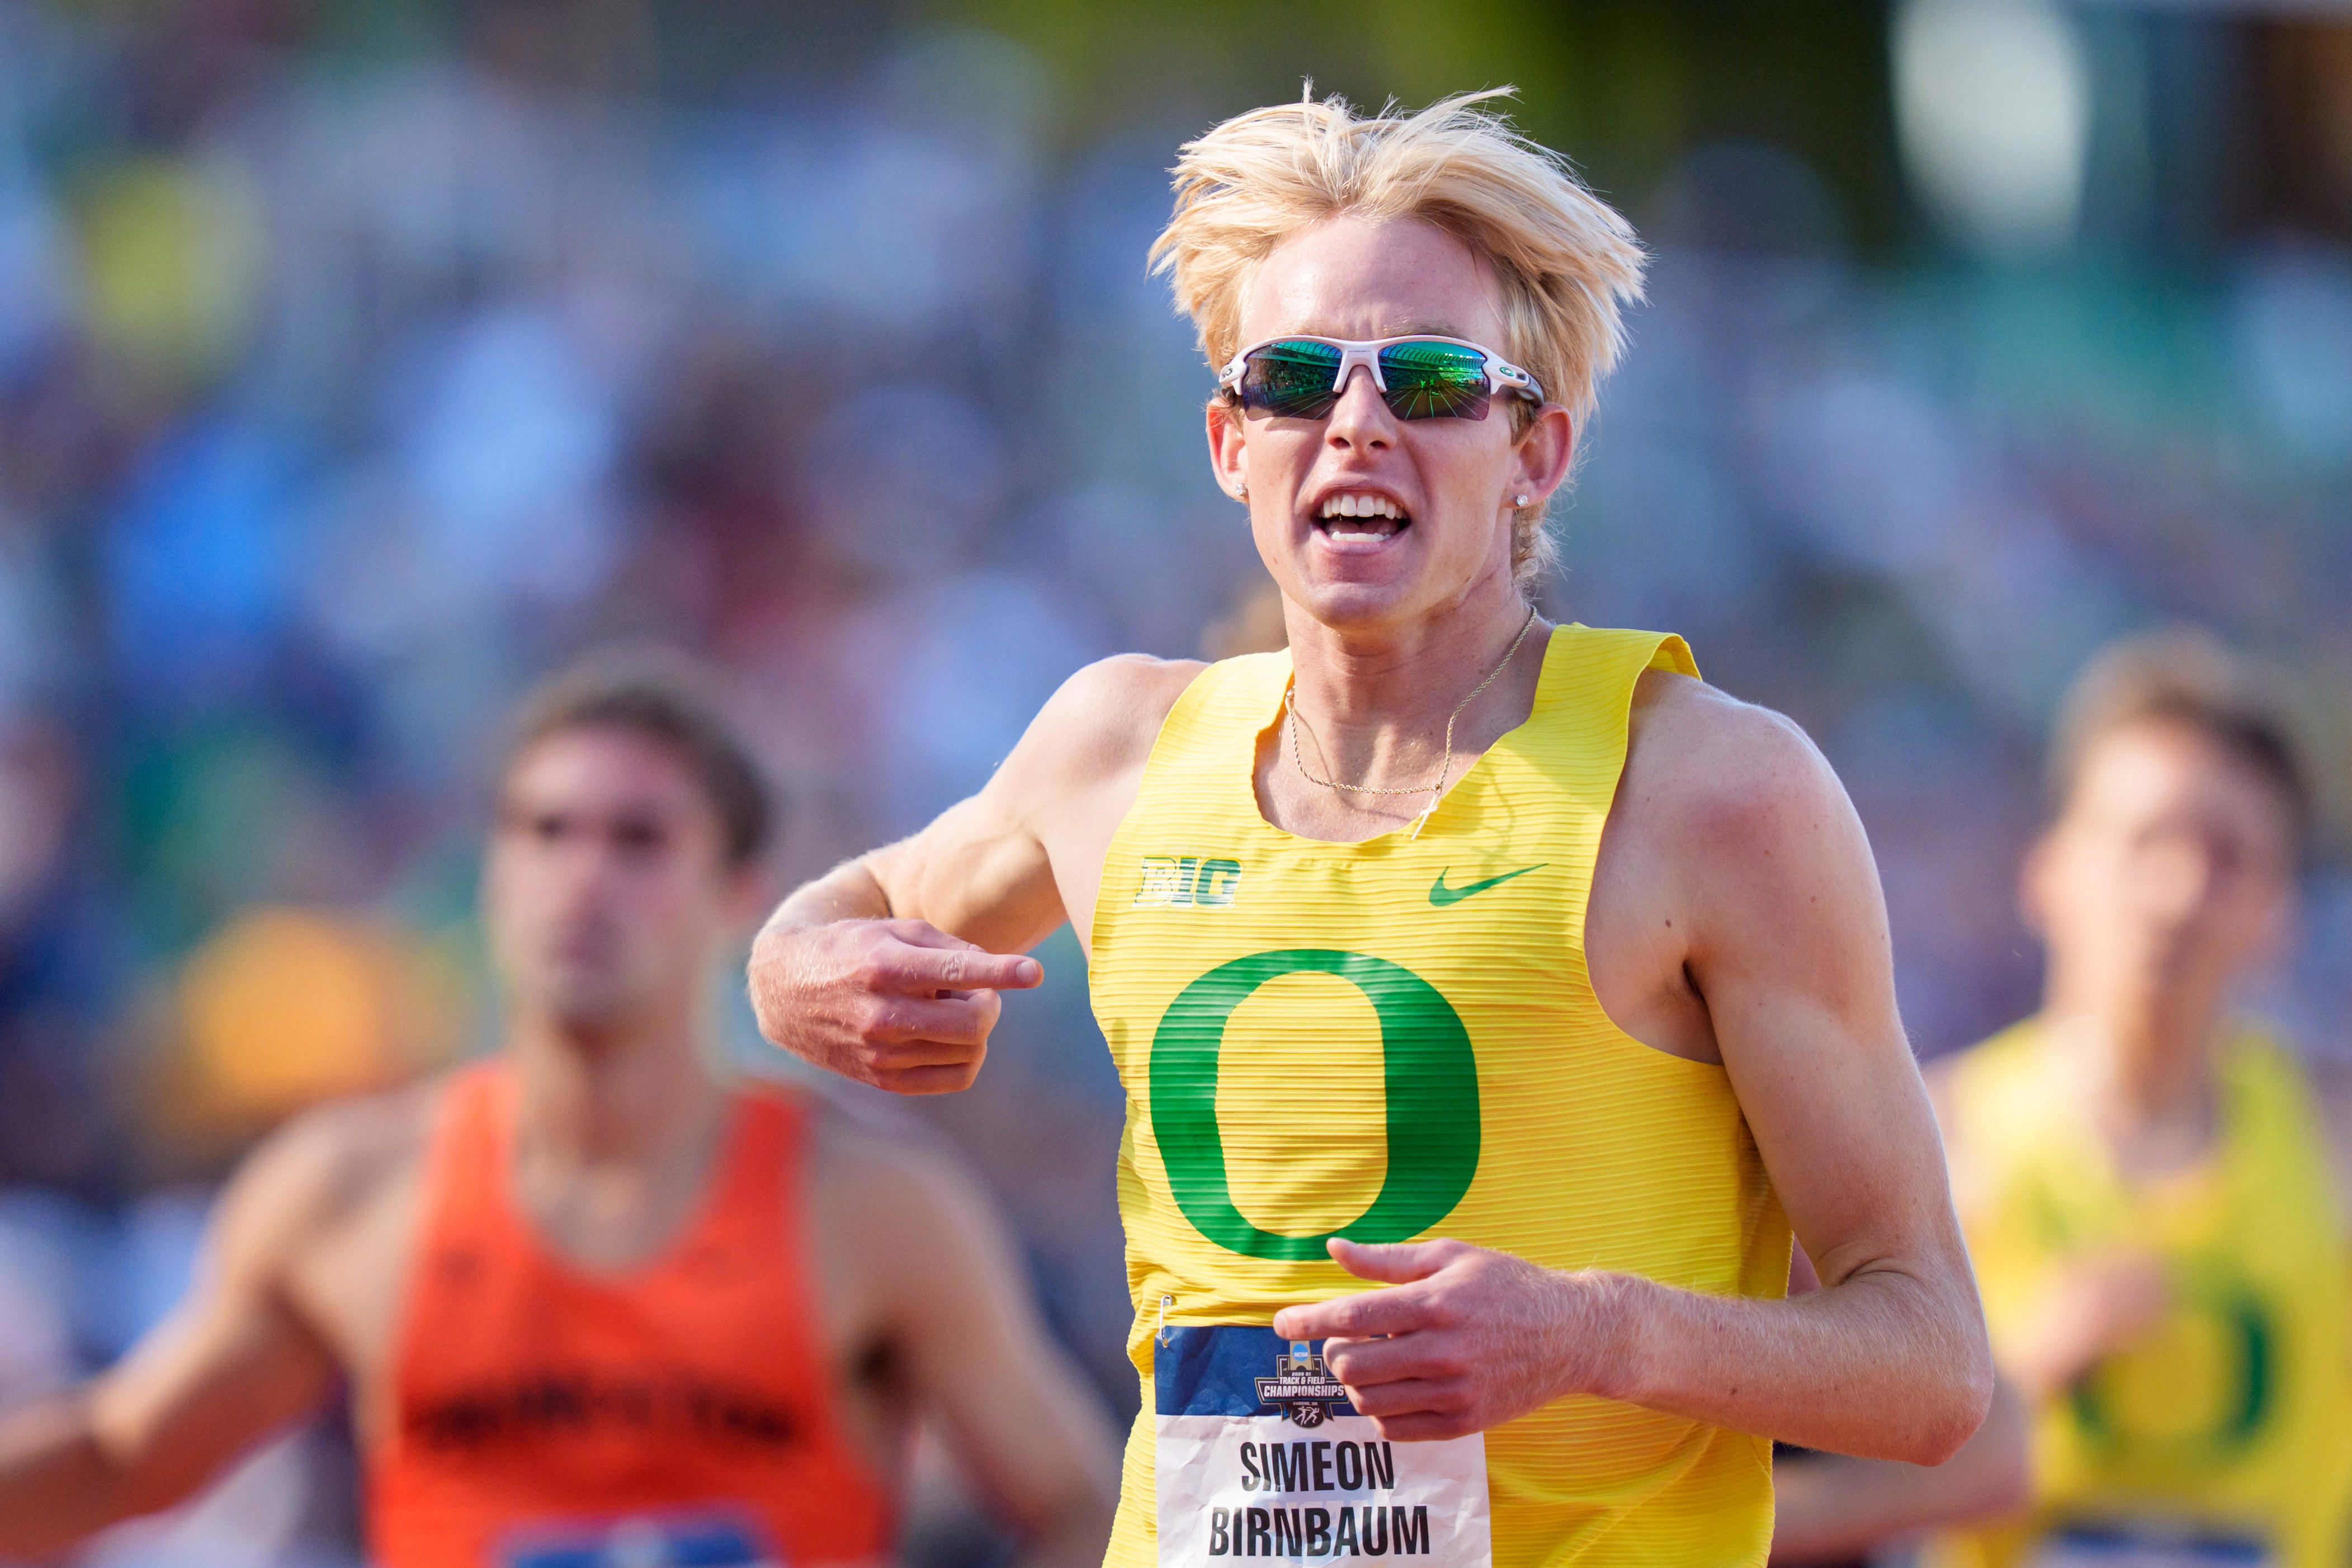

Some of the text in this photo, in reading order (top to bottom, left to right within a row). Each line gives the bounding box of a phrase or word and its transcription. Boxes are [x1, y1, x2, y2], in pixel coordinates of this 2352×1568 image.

[1149, 948, 1481, 1260] O
[1264, 1385, 1345, 1397] CHAMPIONSHIPS
[1279, 1376, 1325, 1385] TRACK & FIELD
[1240, 1441, 1395, 1493] SIMEON
[1208, 1505, 1430, 1557] BIRNBAUM
